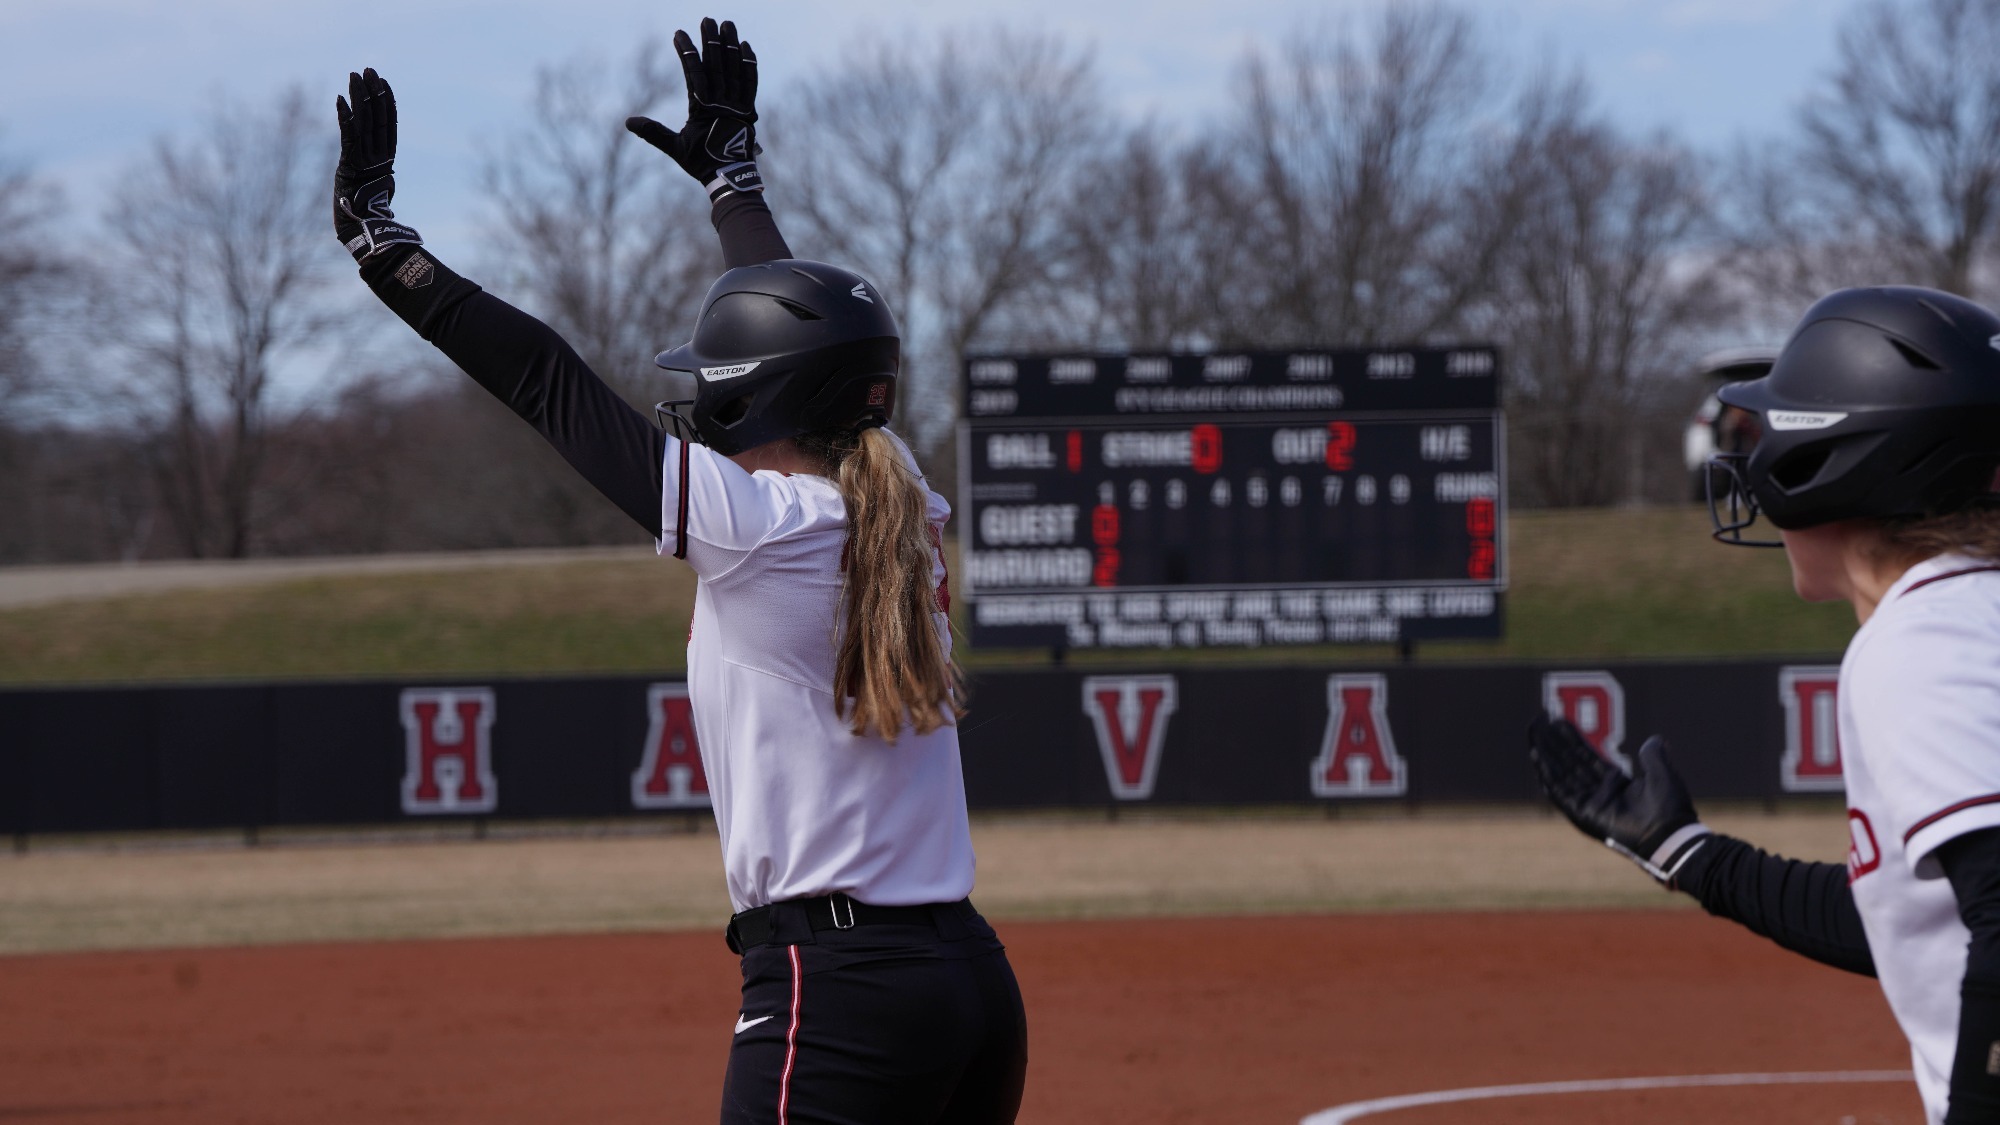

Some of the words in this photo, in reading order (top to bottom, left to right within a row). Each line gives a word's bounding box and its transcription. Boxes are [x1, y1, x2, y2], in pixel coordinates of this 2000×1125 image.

[375, 227, 415, 237] EASTON
[397, 263, 411, 278] OWN
[401, 258, 427, 284] ZONE
[407, 262, 432, 288] SPORTS
[706, 366, 746, 376] EASTON
[1775, 415, 1826, 424] EASTON
[987, 433, 1057, 469] BALL
[1102, 431, 1192, 467] STRIKE
[1190, 423, 1222, 474] 0
[1272, 428, 1328, 464] OUT
[1325, 421, 1356, 471] 2
[980, 505, 1079, 545] GUEST
[967, 548, 1092, 586] HARVARD
